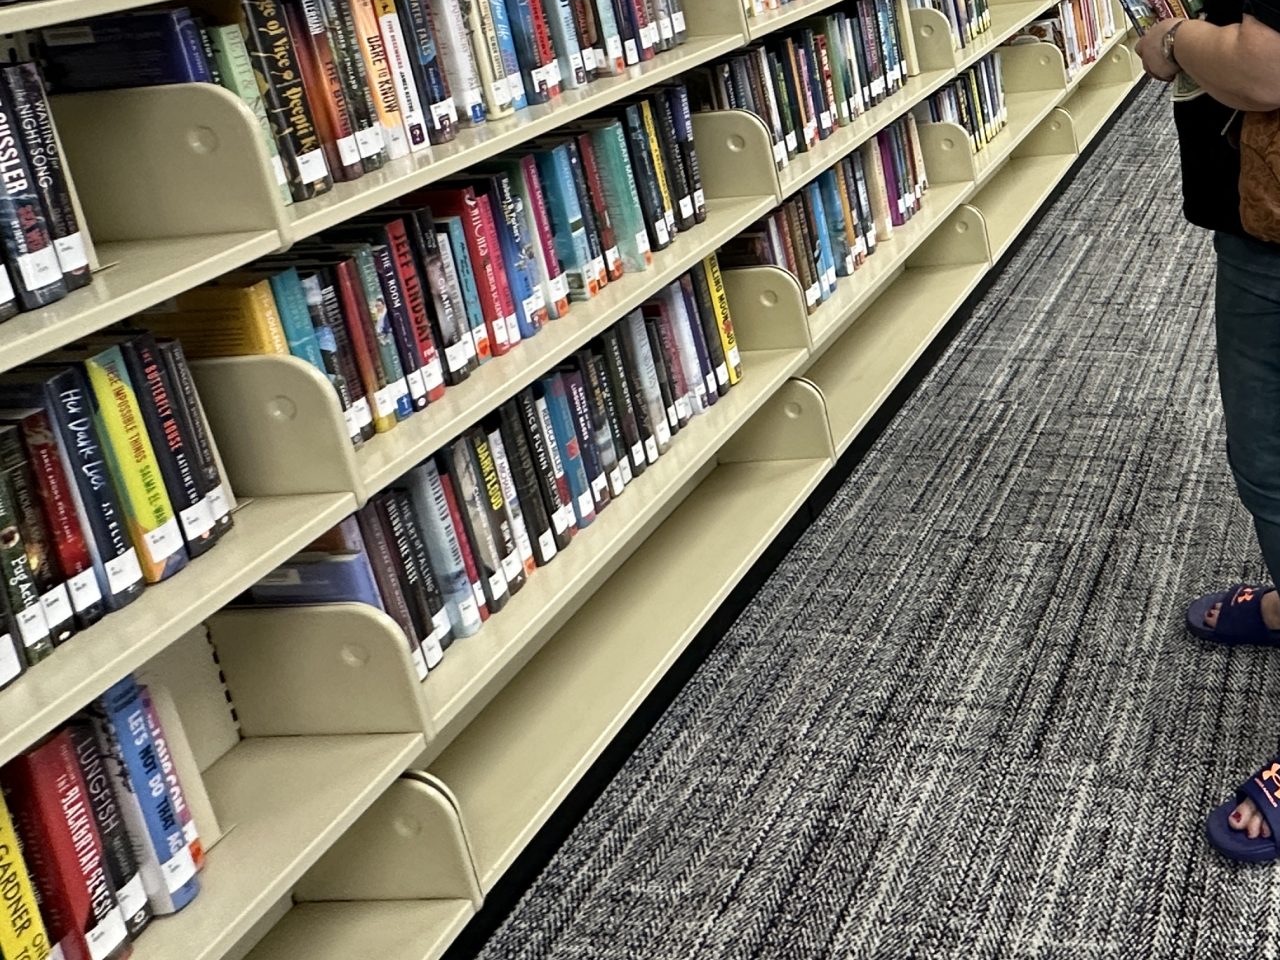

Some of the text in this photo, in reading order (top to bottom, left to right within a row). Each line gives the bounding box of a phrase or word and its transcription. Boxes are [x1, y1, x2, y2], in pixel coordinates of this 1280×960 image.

[366, 34, 385, 66] DARE
[377, 78, 398, 114] KNOW
[399, 70, 409, 91] JAMES
[18, 103, 40, 146] NIGHT
[30, 147, 52, 190] SONG
[33, 99, 57, 156] WAITING
[380, 251, 402, 309] THE ROOM
[145, 364, 171, 418] BUTTERFLY
[113, 385, 139, 434] IMPOSSIBLE
[128, 432, 148, 463] THINGS
[138, 465, 158, 494] SALMA
[177, 452, 196, 488] KATRINE
[522, 396, 550, 471] VINCE FLYNN
[474, 442, 505, 511] DARK FLOOD
[384, 499, 418, 585] FRIENDS LIKE THESE
[405, 521, 419, 541] ART
[415, 551, 437, 594] FALLING
[75, 738, 119, 834] LUNGFISH
[138, 746, 157, 775] NOT
[148, 775, 164, 798] DO
[156, 799, 175, 832] THAT
[0, 842, 36, 939] GARDNER
